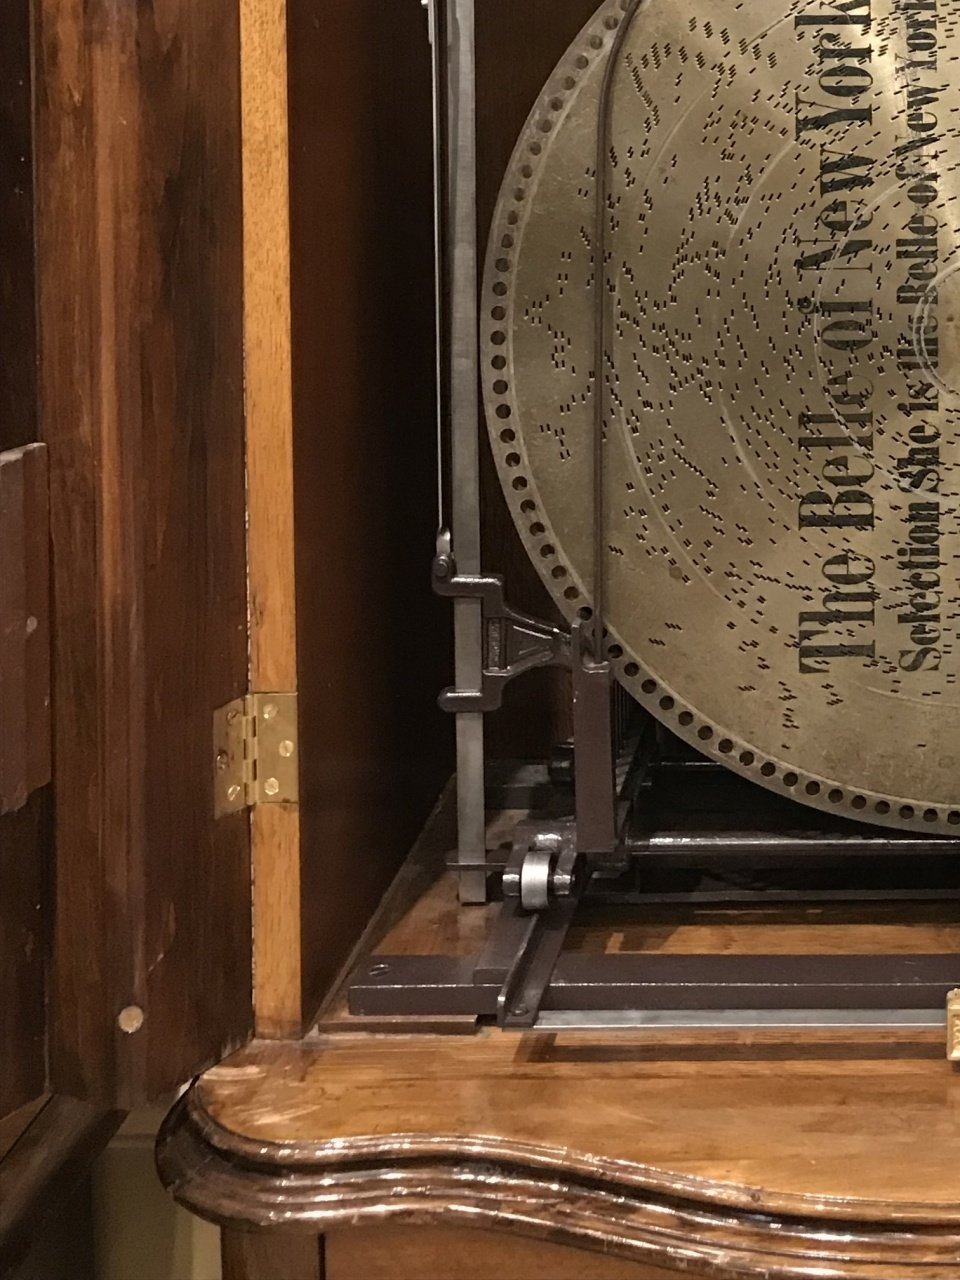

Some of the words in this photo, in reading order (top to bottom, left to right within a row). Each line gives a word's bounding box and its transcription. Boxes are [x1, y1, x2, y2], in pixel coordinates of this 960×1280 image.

[894, 84, 942, 163] New
[793, 144, 876, 276] New
[894, 164, 939, 205] of
[895, 213, 939, 306] Belle
[796, 295, 874, 352] of
[896, 314, 940, 370] the
[896, 378, 940, 413] is
[797, 373, 877, 532] Belle
[896, 423, 941, 495] She
[797, 551, 877, 674] The
[896, 500, 941, 674] Selection
